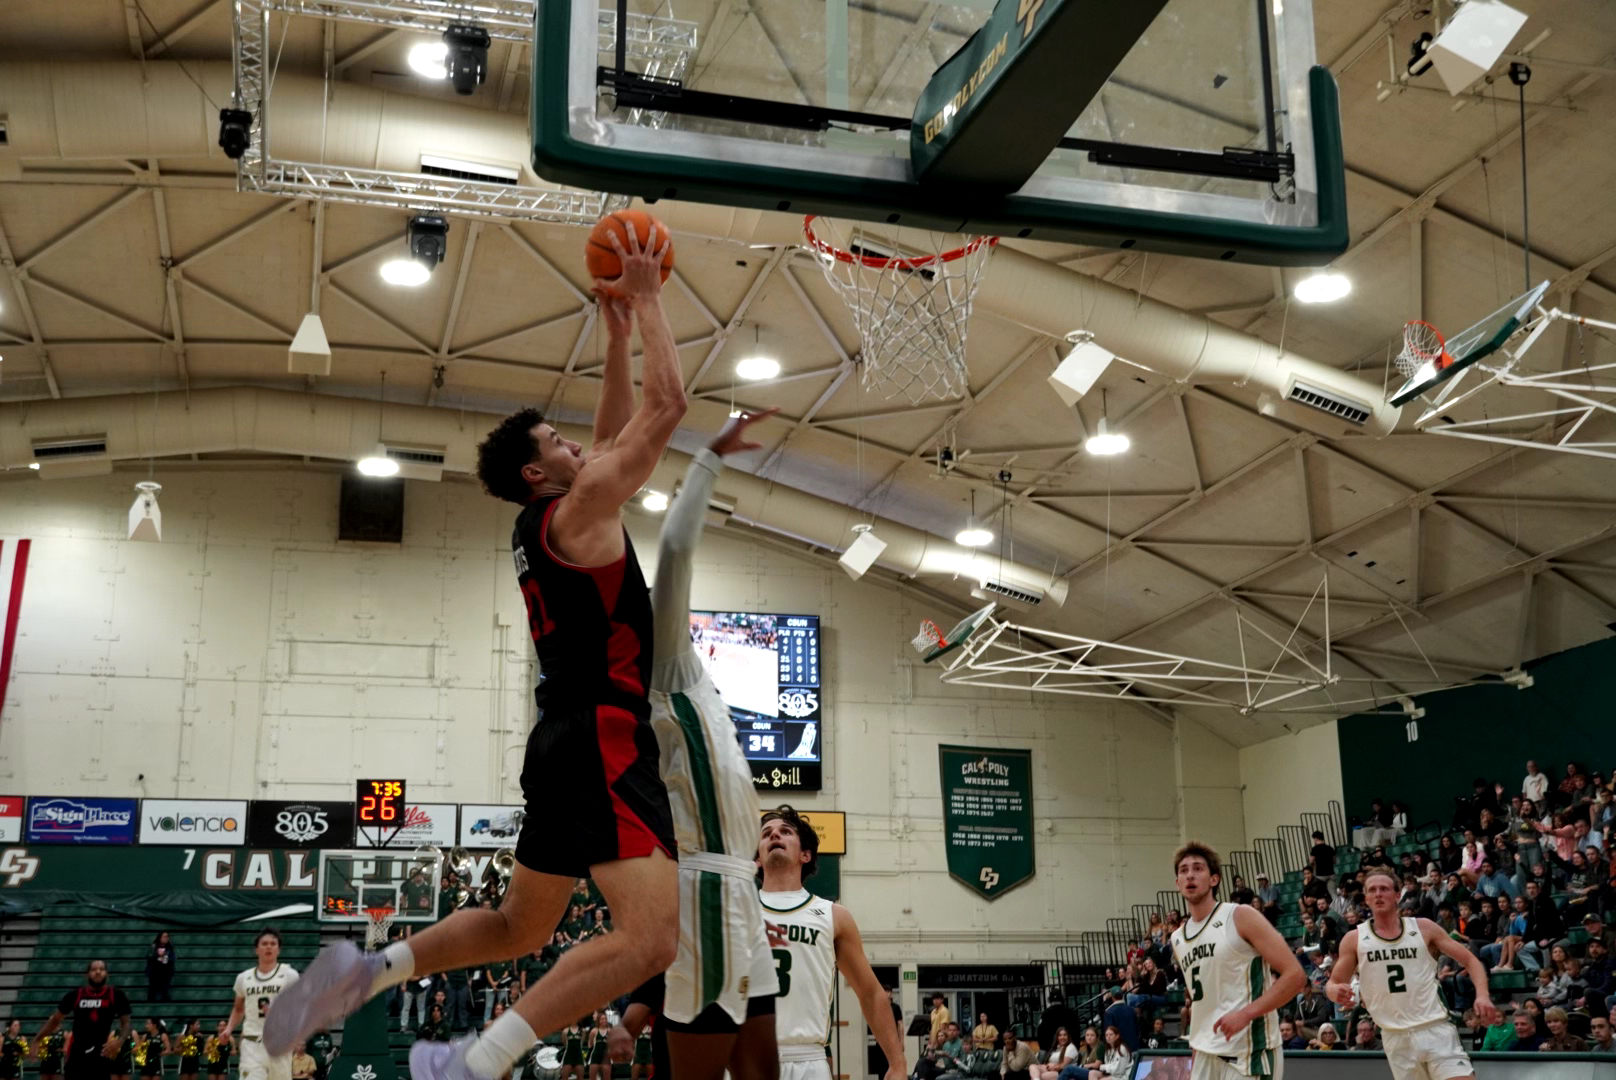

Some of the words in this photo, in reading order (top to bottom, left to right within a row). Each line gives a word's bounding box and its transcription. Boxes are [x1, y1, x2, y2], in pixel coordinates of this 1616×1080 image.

[923, 31, 1008, 144] GOPOLY.COM
[787, 618, 807, 627] CSUN
[810, 638, 816, 646] 0
[810, 656, 816, 665] 0
[796, 665, 803, 673] 0
[811, 666, 816, 674] 1
[796, 675, 803, 683] 4
[810, 675, 816, 683] 0
[778, 692, 818, 713] 805
[752, 721, 771, 731] CSUN
[749, 735, 775, 752] 34
[962, 763, 978, 775] CAL
[988, 764, 1009, 777] POLY
[372, 782, 402, 796] 7:35
[964, 776, 1009, 786] WRESTLING
[46, 806, 84, 824] Sign
[85, 806, 130, 823] Place
[361, 797, 395, 820] 26
[149, 814, 237, 832] valencia
[274, 811, 329, 834] 805
[204, 851, 316, 889] CAL
[777, 923, 821, 946] POLY
[1192, 943, 1216, 962] POLY
[1366, 949, 1389, 963] CAL
[1389, 947, 1418, 960] POLY
[1191, 966, 1204, 1002] 5
[1386, 965, 1407, 993] 2
[246, 987, 261, 996] CAL
[262, 984, 281, 995] POLY
